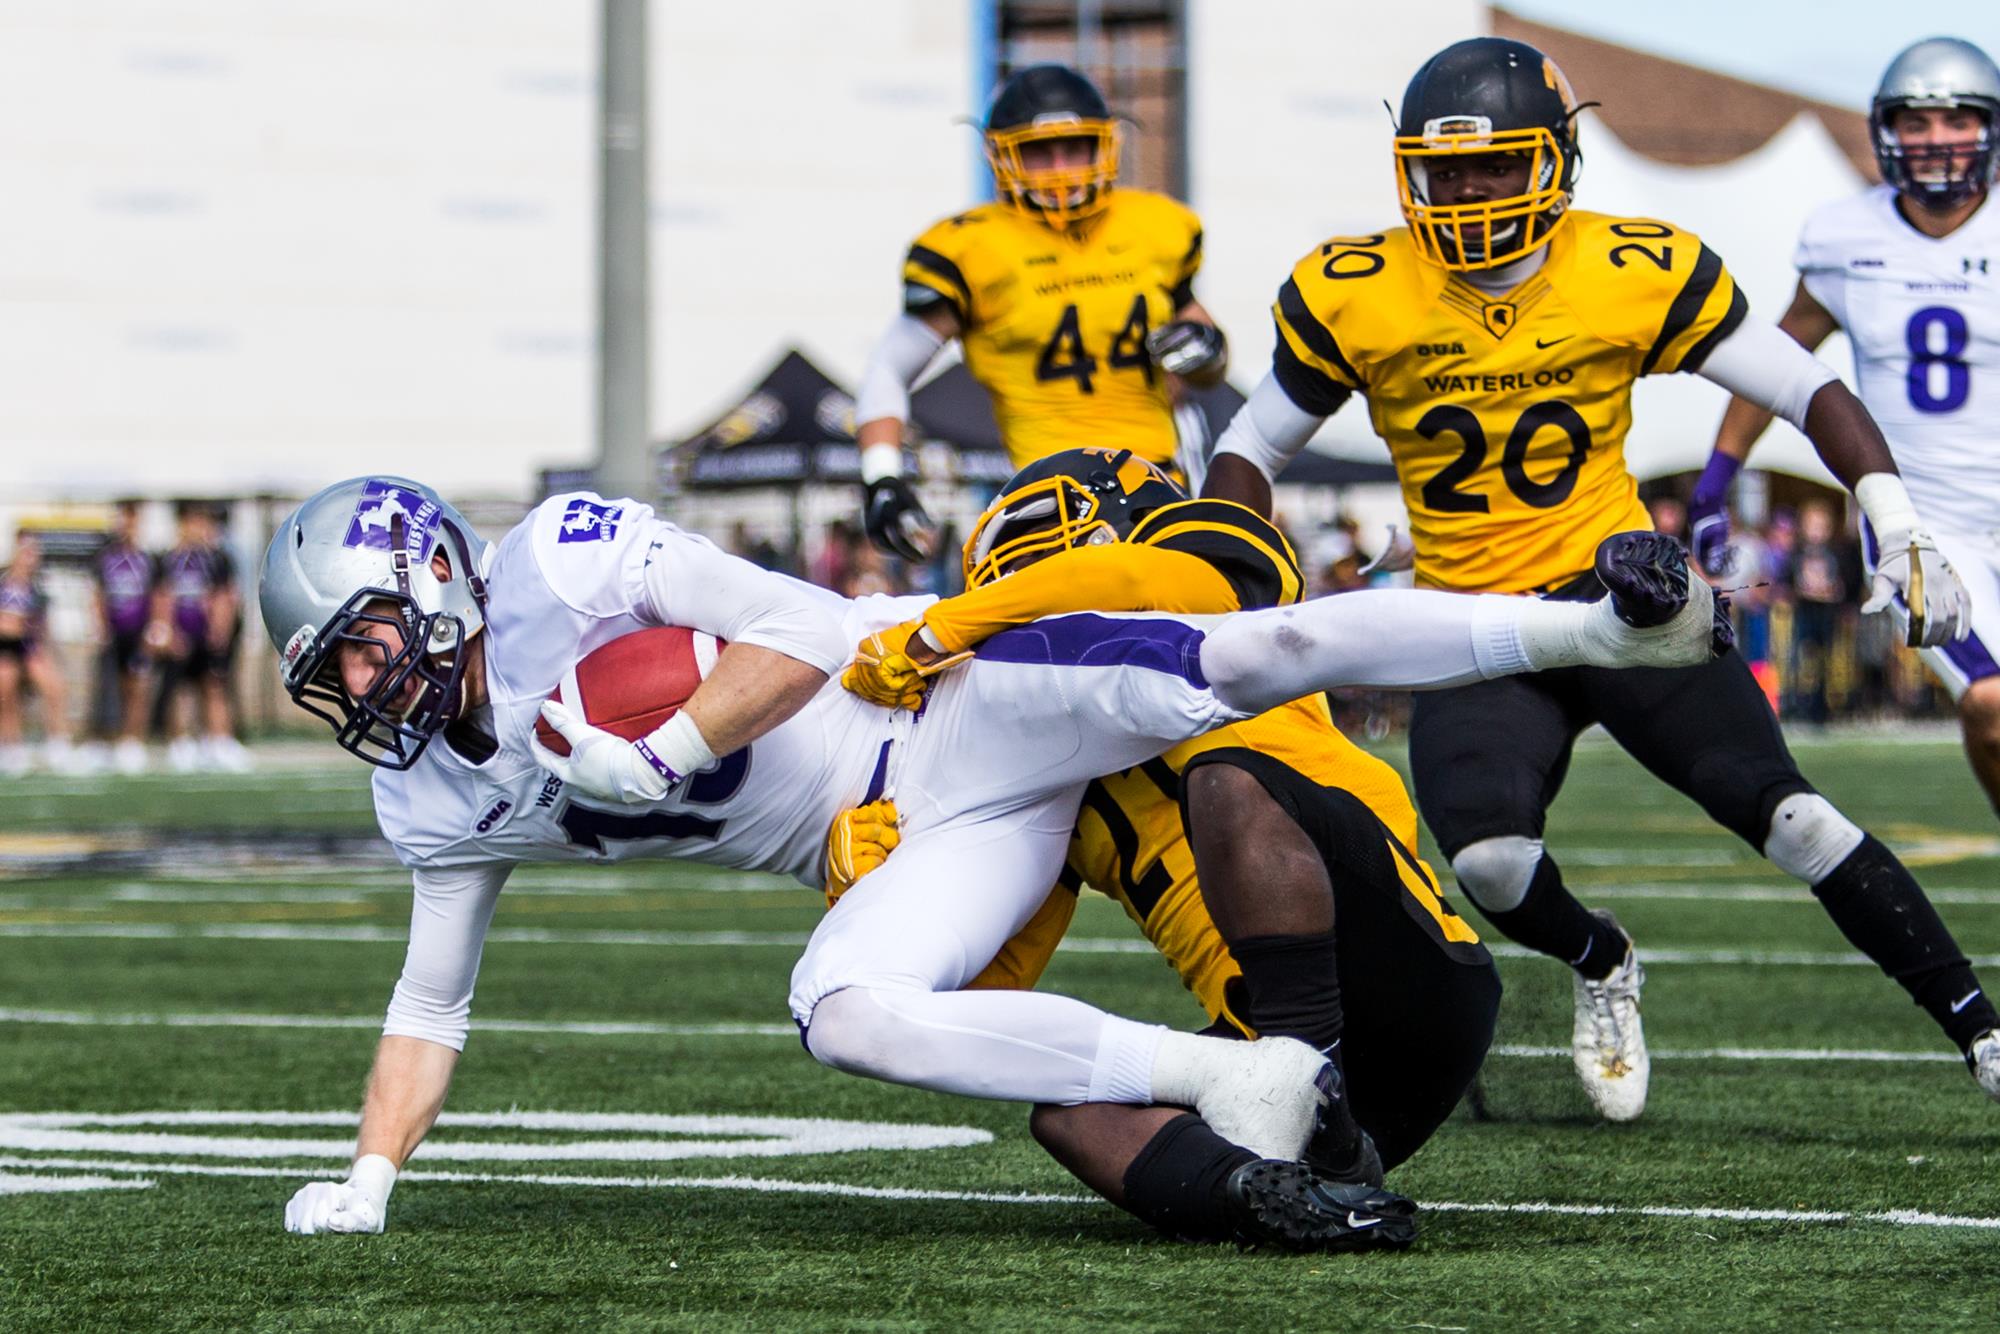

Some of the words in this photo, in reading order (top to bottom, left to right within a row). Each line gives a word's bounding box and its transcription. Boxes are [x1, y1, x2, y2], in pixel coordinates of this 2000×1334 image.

[1322, 234, 1386, 280] 20
[1609, 222, 1674, 272] 20
[1035, 293, 1156, 395] 44
[1906, 305, 1971, 415] 8
[1424, 368, 1575, 392] WATERLOO
[1415, 400, 1592, 514] 20
[476, 799, 513, 833] OUA
